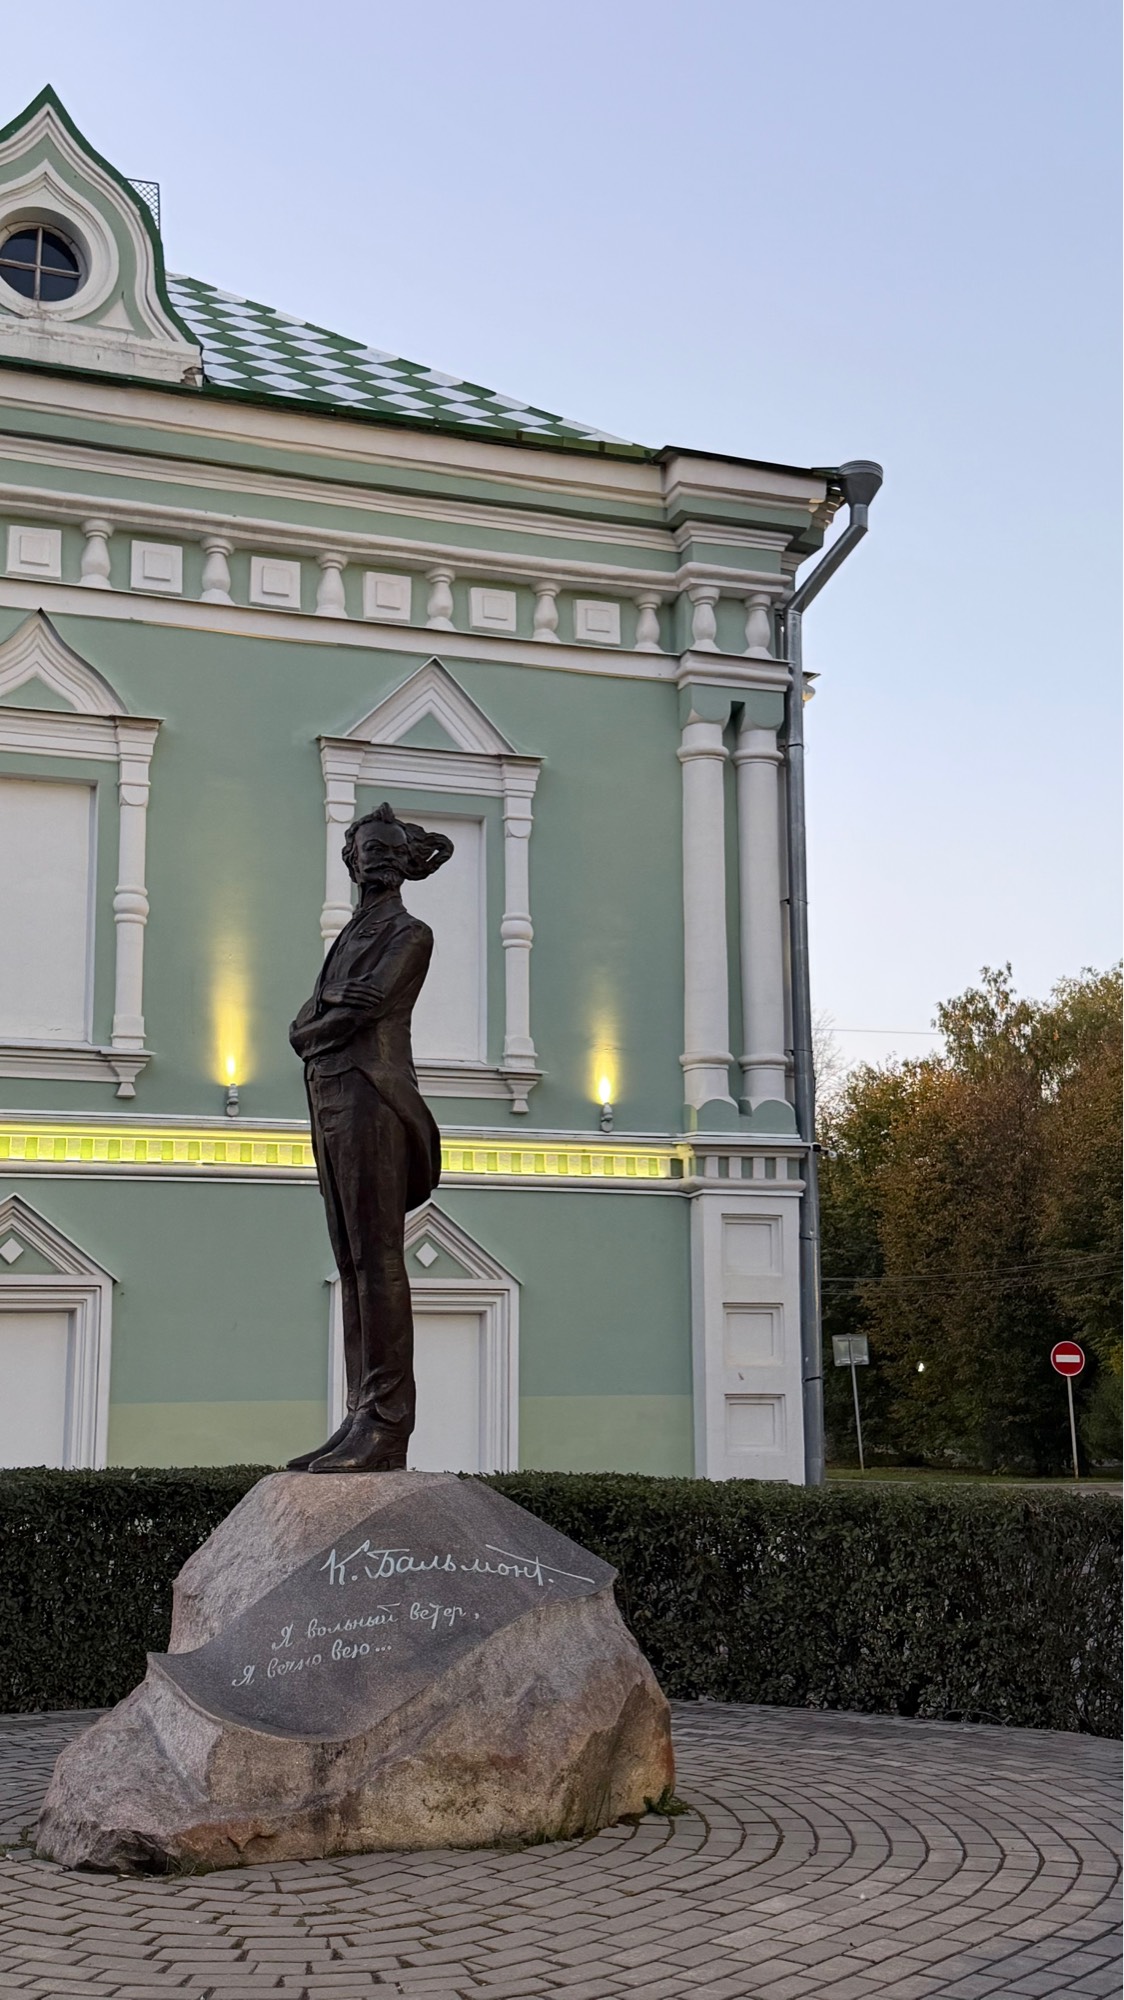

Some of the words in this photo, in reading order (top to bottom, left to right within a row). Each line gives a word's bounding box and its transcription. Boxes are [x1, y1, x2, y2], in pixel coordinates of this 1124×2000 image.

[271, 1624, 294, 1650] Я
[307, 1602, 400, 1638] вольный
[231, 1665, 255, 1687] Я
[266, 1654, 322, 1679] вечно
